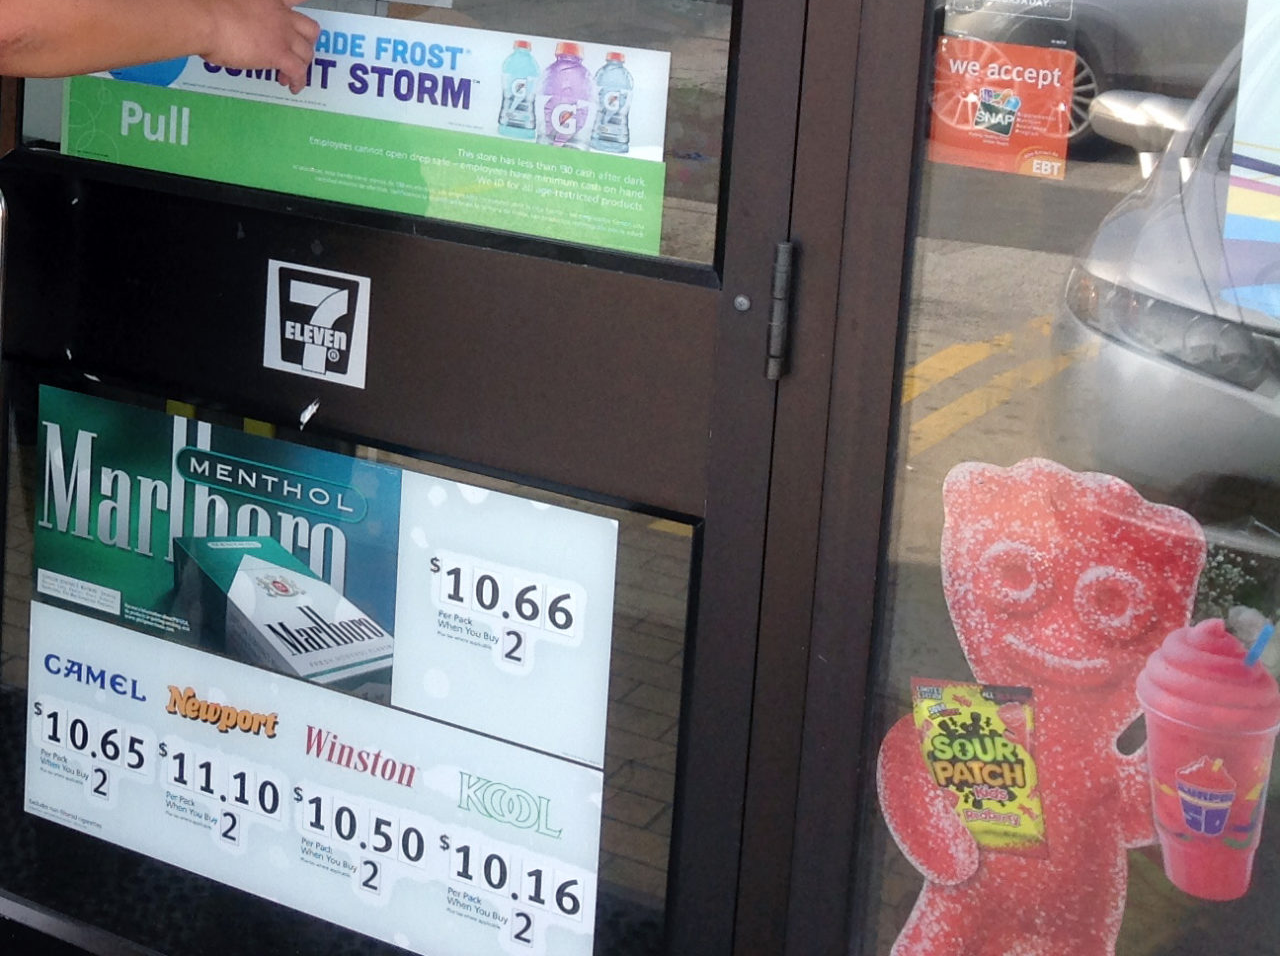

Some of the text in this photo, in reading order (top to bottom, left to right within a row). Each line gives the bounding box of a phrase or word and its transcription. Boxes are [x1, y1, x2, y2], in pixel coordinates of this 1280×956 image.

[315, 29, 464, 70] ADE FROST
[348, 62, 471, 110] STORM
[949, 58, 1062, 90] we accept
[121, 100, 190, 146] Pull
[976, 110, 1015, 125] SNAP
[309, 136, 578, 188] Employees employees minimum
[457, 147, 534, 169] This store has less
[1032, 160, 1061, 175] EBT
[289, 279, 349, 374] 7
[38, 415, 346, 596] Marlboro
[190, 457, 353, 512] MENTHOL
[430, 557, 573, 630] $10.66
[267, 605, 386, 656] Marlboro
[437, 619, 463, 632] When
[466, 626, 481, 638] You
[483, 631, 499, 644] Buy
[504, 630, 523, 662] 2
[454, 614, 472, 626] Pack
[44, 653, 563, 839] CAMEL Newport Winston KOOL
[933, 736, 1017, 762] SOUR
[40, 757, 61, 772] When
[93, 768, 108, 796] 2
[933, 761, 1025, 788] PATCH
[973, 784, 1009, 800] Kids
[34, 701, 144, 769] $10.65
[158, 742, 280, 814] $11.10
[293, 786, 425, 862] $10.50
[439, 834, 580, 916] $10.16
[166, 800, 187, 813] When
[222, 812, 237, 841] 2
[964, 809, 1020, 828] Redberry
[300, 846, 324, 861] When
[325, 854, 340, 867] You
[342, 860, 357, 873] Buy
[361, 860, 378, 891] 2
[447, 896, 472, 912] When
[473, 904, 490, 918] You
[492, 911, 508, 925] Buy
[513, 912, 532, 943] 2
